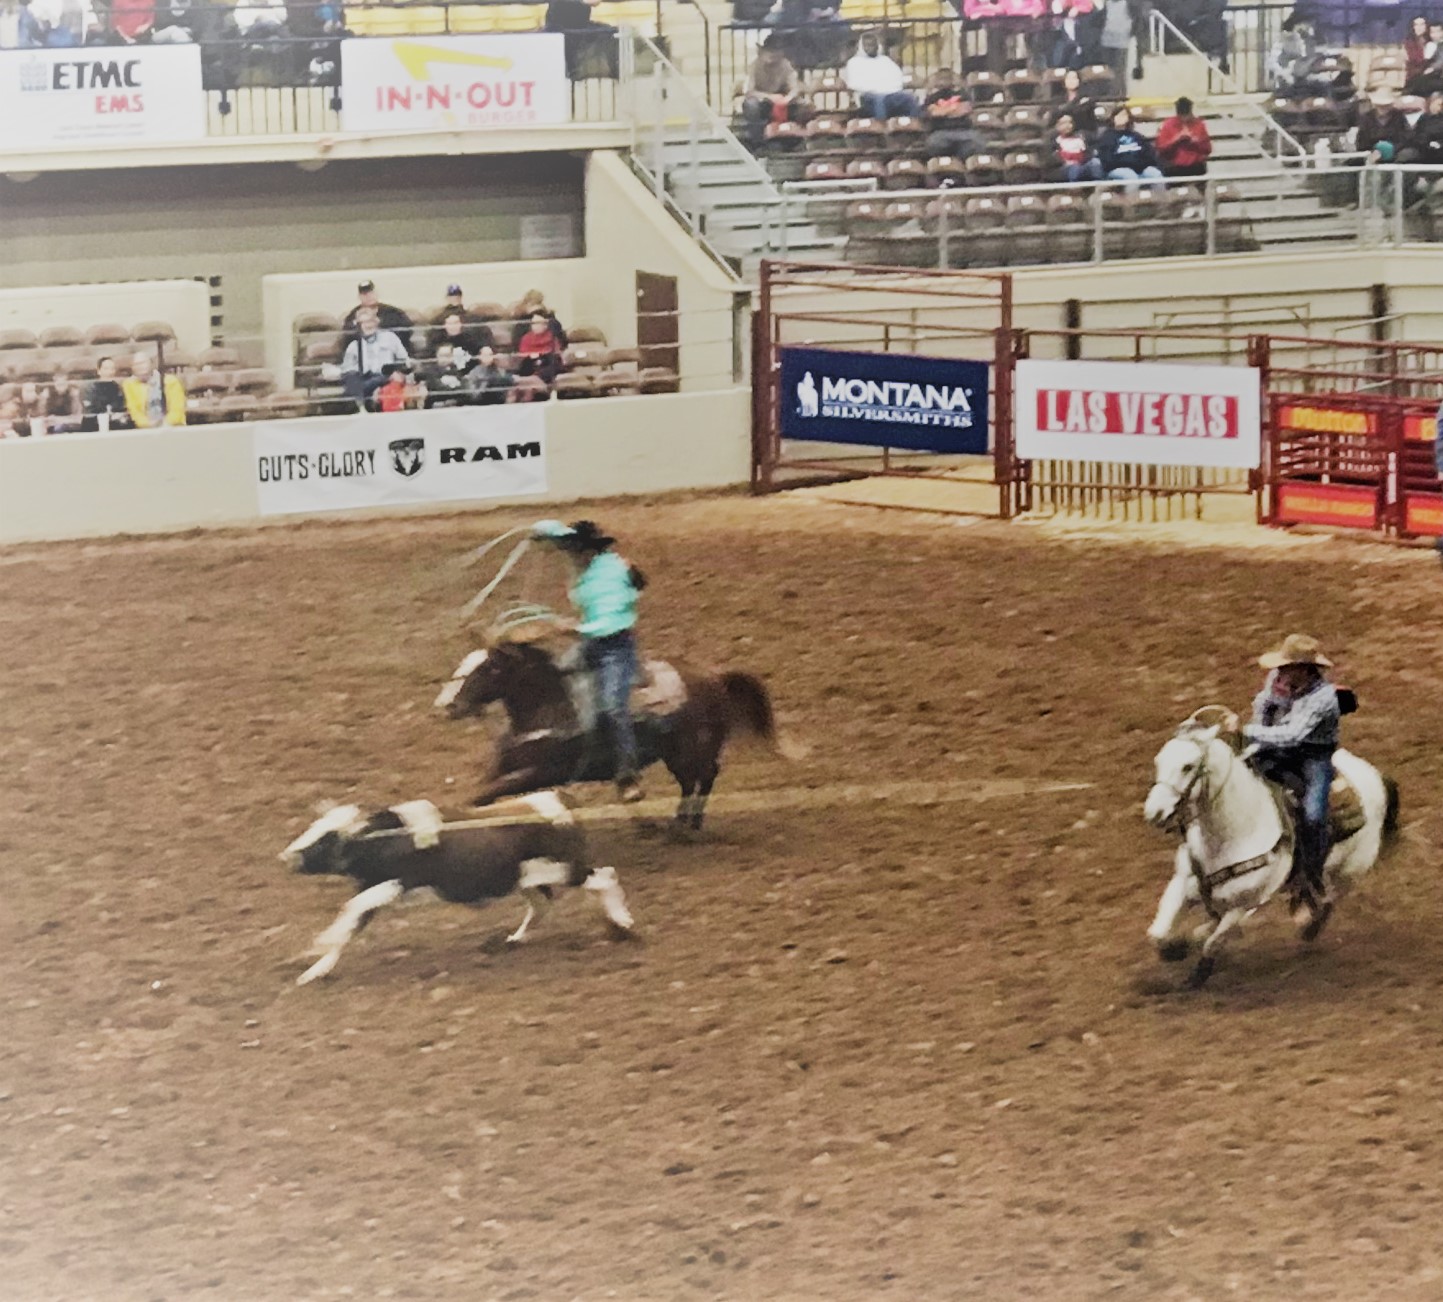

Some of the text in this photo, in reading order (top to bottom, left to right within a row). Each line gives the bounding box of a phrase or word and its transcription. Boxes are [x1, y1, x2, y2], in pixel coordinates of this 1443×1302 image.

[52, 60, 142, 90] ETMC
[95, 94, 144, 114] EMS
[468, 110, 536, 125] BURGER
[822, 376, 972, 411] MONTANA
[821, 405, 973, 428] SILVERSMITHS
[1047, 390, 1228, 438] LAS VEGAS
[439, 441, 541, 464] RAM
